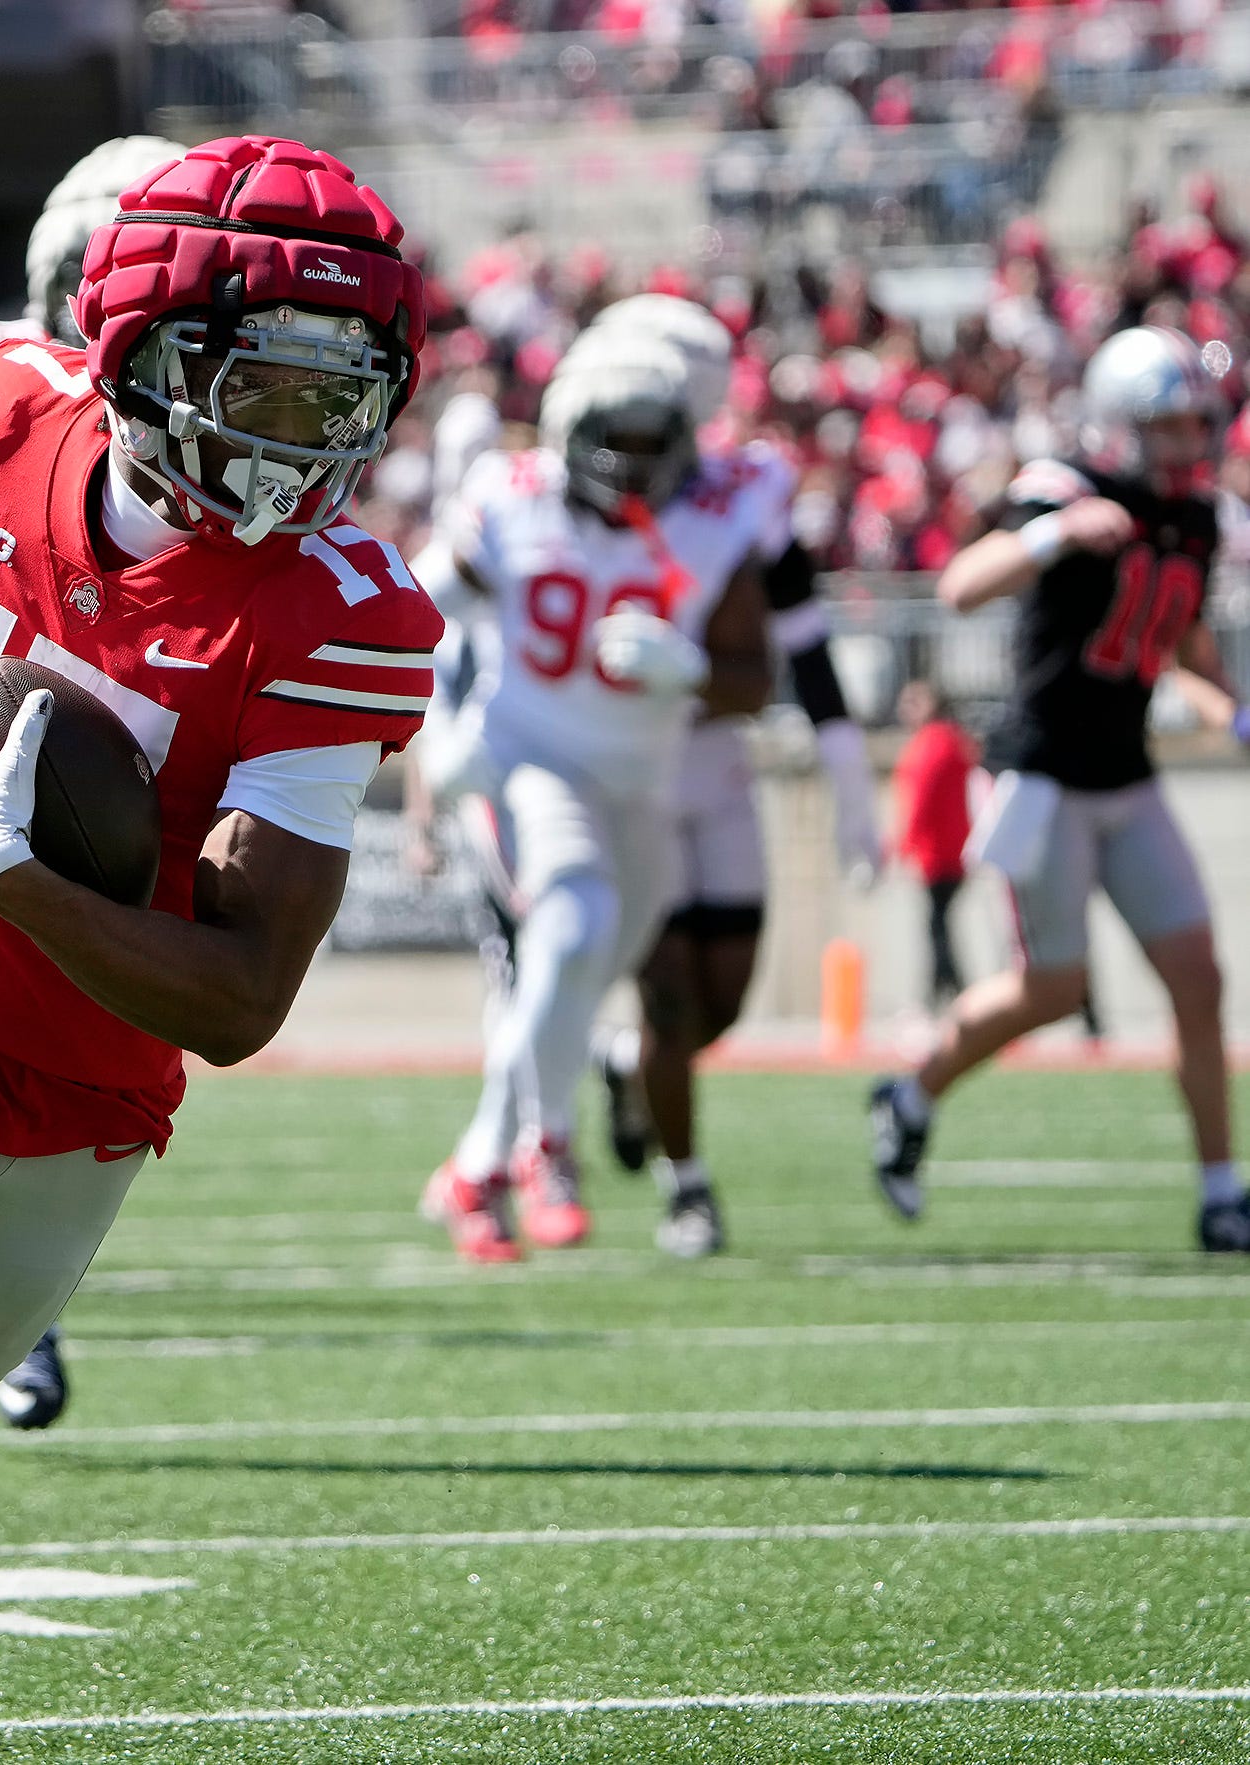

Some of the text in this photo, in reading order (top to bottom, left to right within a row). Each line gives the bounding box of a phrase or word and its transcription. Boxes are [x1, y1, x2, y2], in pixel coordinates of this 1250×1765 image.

[303, 268, 360, 286] GUARDIAN
[298, 524, 419, 607] 17
[1083, 542, 1203, 688] 10
